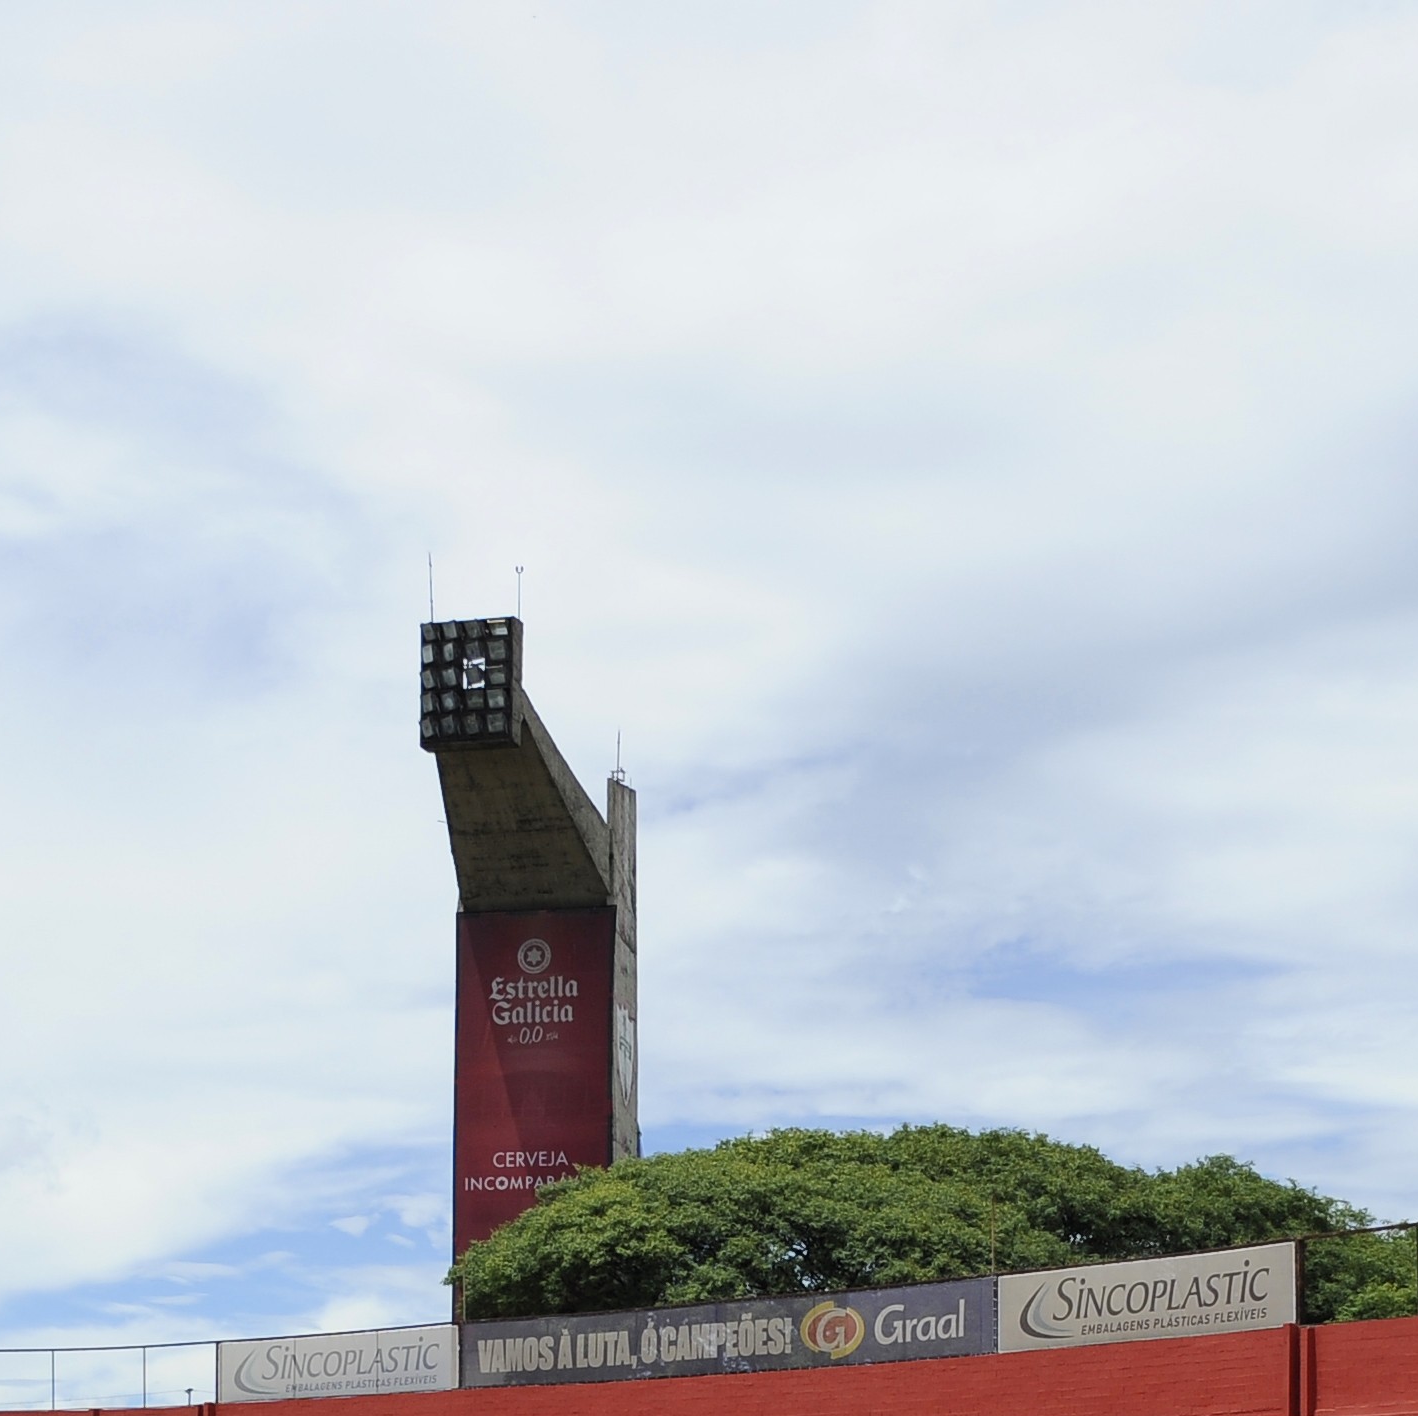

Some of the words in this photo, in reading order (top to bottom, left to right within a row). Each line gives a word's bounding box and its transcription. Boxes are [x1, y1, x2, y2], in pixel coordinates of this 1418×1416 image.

[489, 976, 578, 1000] Estrella
[492, 1000, 573, 1025] Galicia
[493, 1151, 568, 1168] CERVEJA
[874, 1299, 966, 1345] Graal
[1081, 1319, 1150, 1335] EMBALAGENS
[1153, 1313, 1210, 1329] PLÁSTICAS
[1213, 1307, 1268, 1324] FLEXÍVEIS
[478, 1336, 555, 1373] VAMOS
[557, 1328, 572, 1369] À
[576, 1330, 637, 1369] LUTA,
[660, 1313, 792, 1363] CAMPEÕES!
[285, 1381, 343, 1393] EMBALAGENS
[345, 1378, 392, 1389] PLÁSTICAS
[394, 1374, 437, 1387] FLEXÍVEIS
